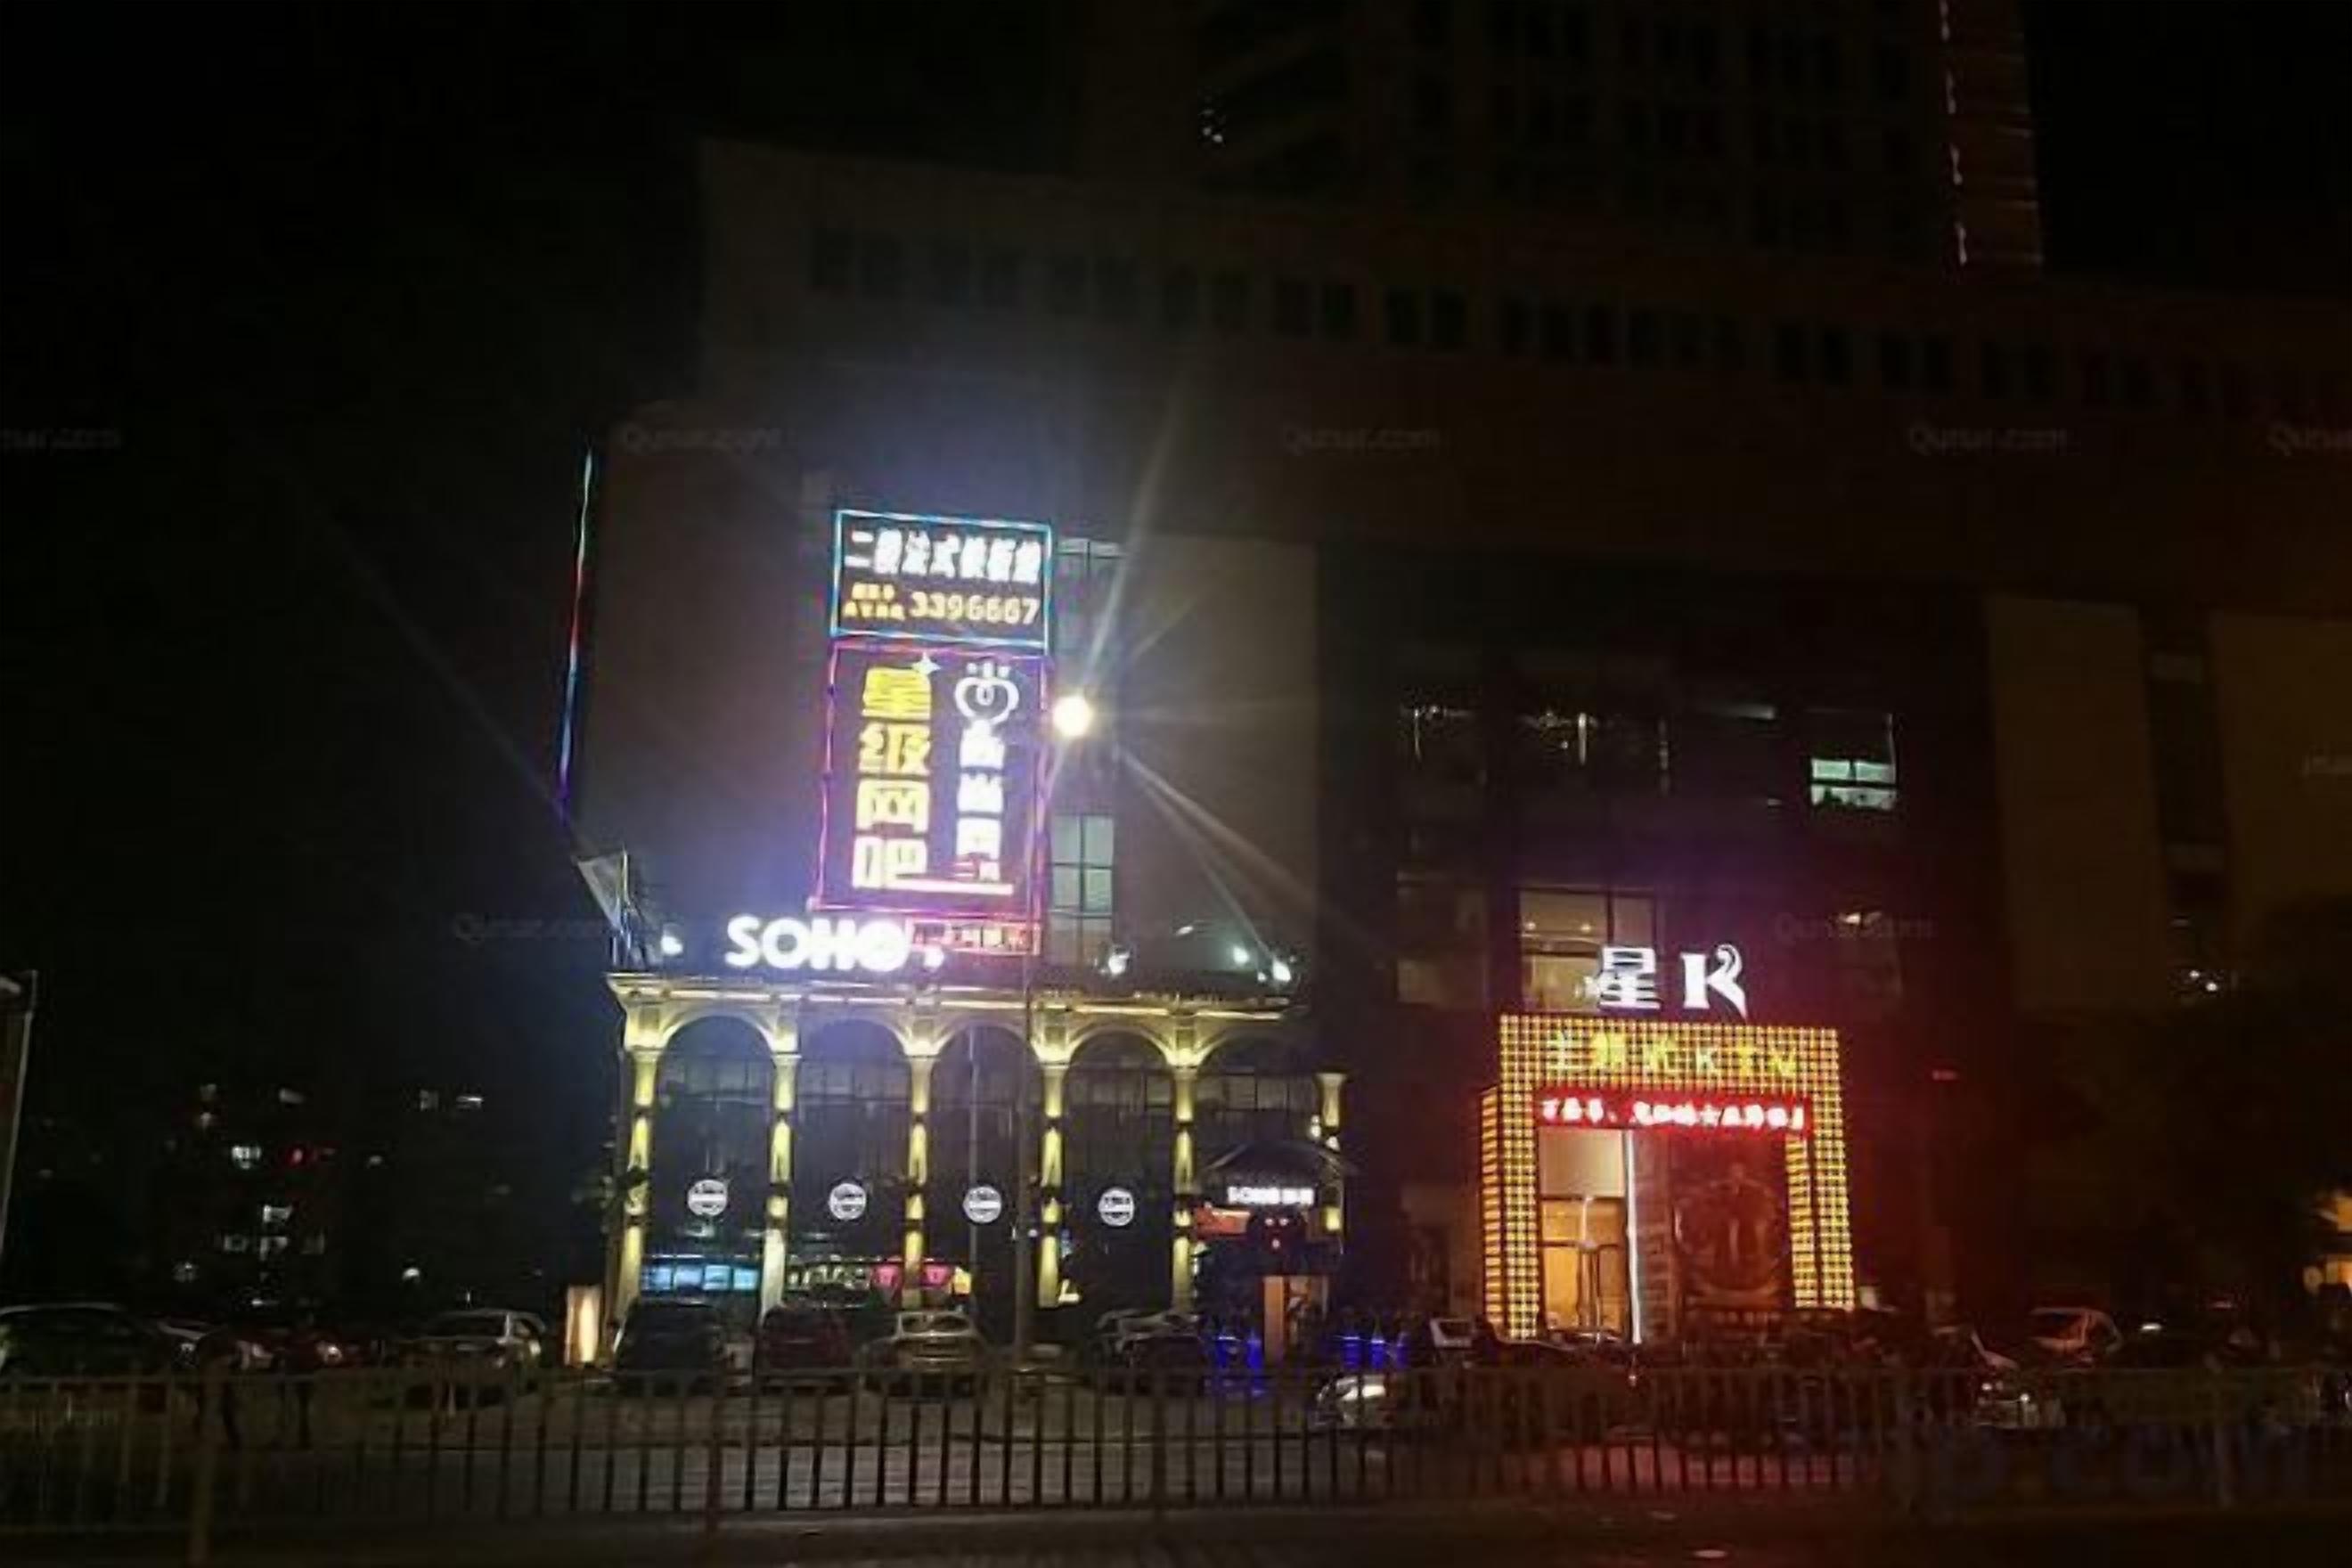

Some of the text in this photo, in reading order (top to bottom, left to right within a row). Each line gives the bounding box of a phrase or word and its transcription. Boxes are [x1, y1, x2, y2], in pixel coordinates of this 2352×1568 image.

[853, 659, 935, 893] 星级网吧
[725, 915, 911, 971] SOHO
